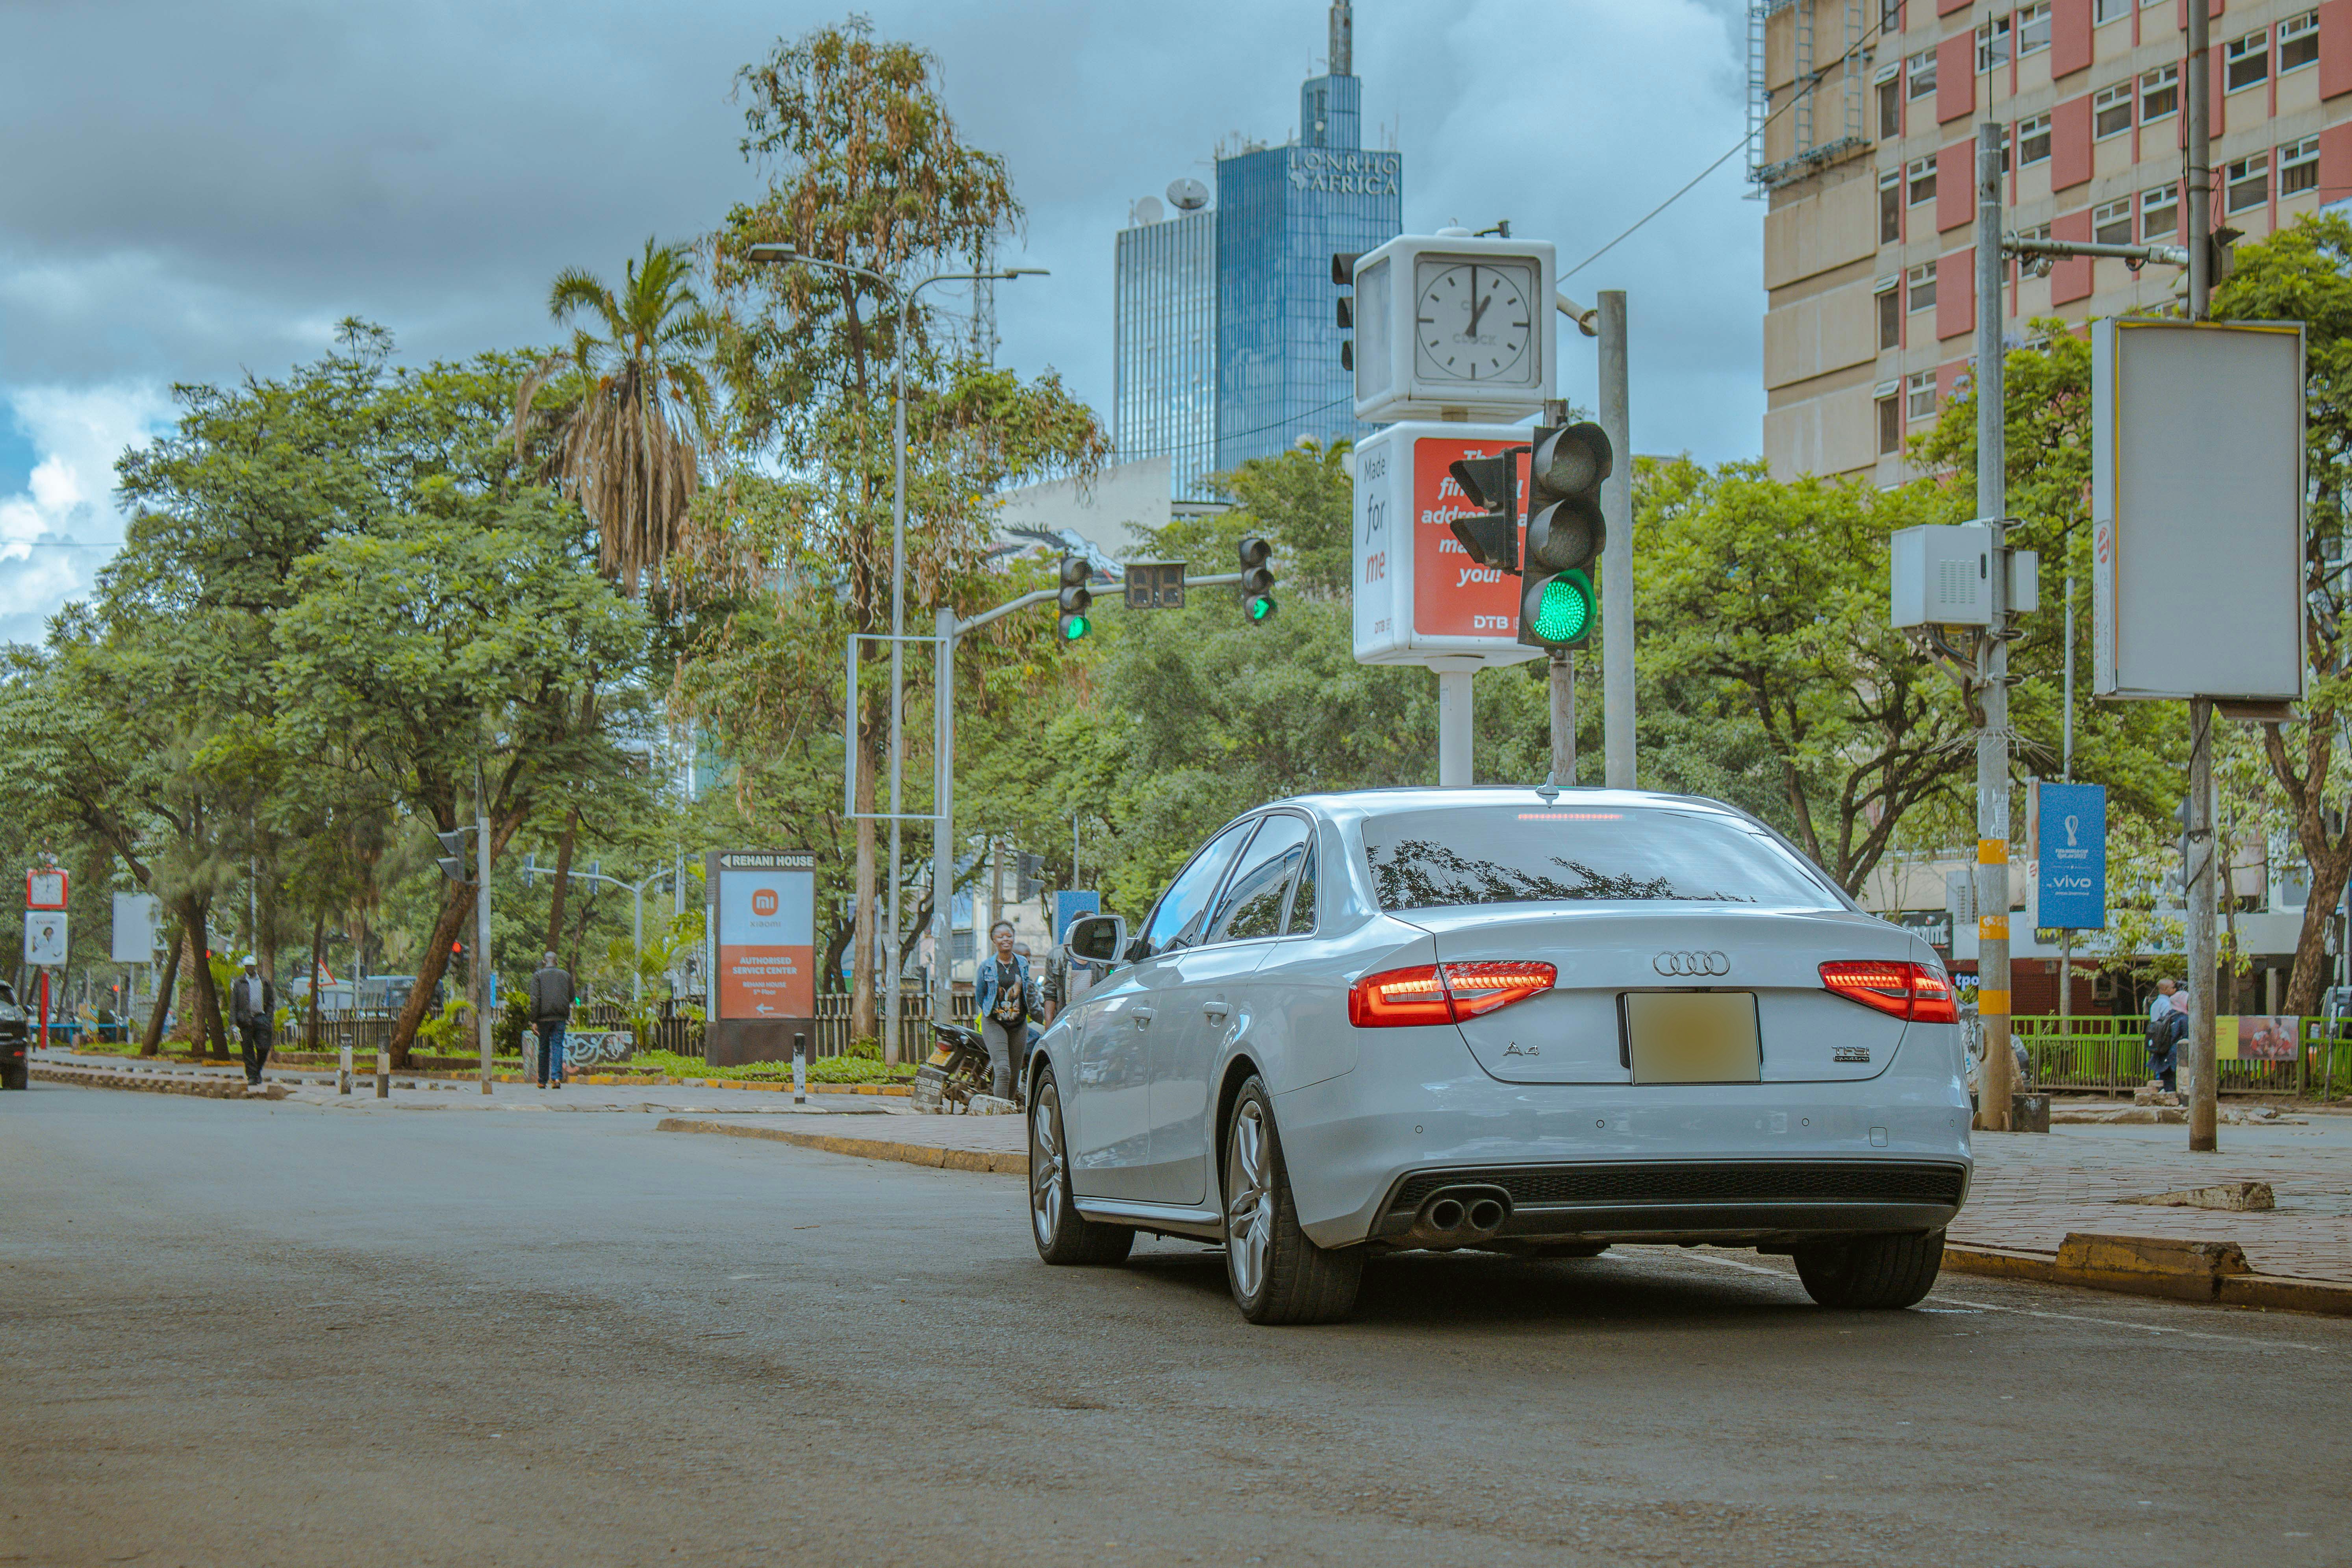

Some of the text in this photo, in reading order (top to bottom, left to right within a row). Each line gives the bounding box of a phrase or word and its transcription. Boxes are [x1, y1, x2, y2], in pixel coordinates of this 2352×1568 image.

[1290, 151, 1398, 175] LONRHO
[1310, 173, 1397, 195] AFRICA
[1364, 452, 1385, 483] Made
[1366, 493, 1385, 545] for
[1366, 550, 1385, 584] me
[1457, 568, 1502, 587] you!
[1474, 615, 1509, 629] DTB
[732, 855, 814, 867] REHANI HOUSE
[2053, 875, 2091, 888] vivo
[1503, 1041, 1539, 1056] A4
[1831, 1046, 1869, 1056] TFSI
